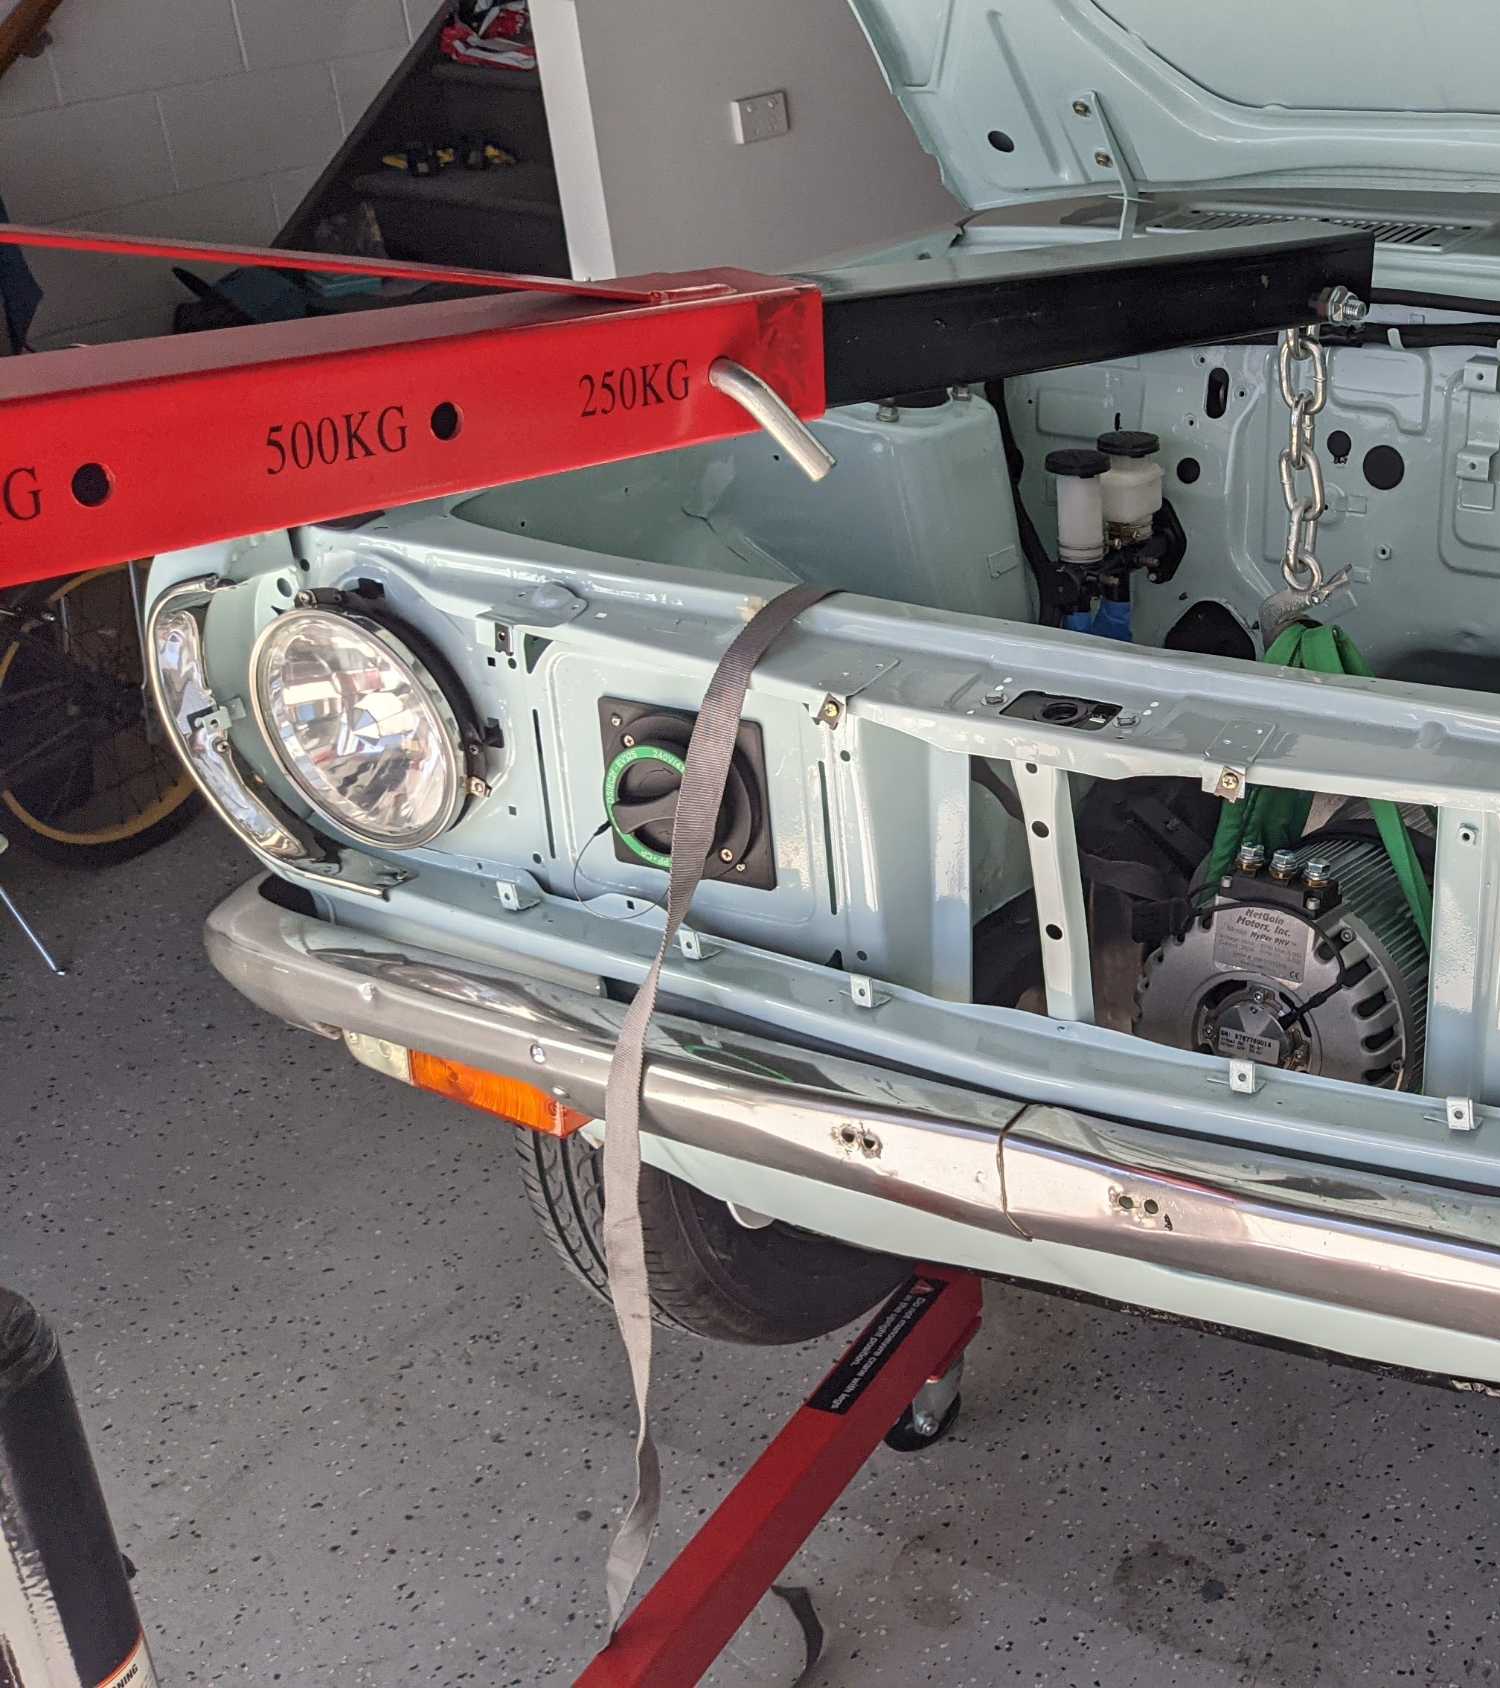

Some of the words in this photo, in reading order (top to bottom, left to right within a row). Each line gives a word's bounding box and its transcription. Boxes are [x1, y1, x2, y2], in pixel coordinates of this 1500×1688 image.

[579, 359, 689, 417] 250KG
[266, 405, 408, 475] 500KG
[0, 466, 42, 525] G
[1236, 916, 1270, 932] Motors,
[1274, 926, 1291, 937] Inc.
[1245, 908, 1284, 925] NetGain
[112, 1663, 138, 1688] NING
